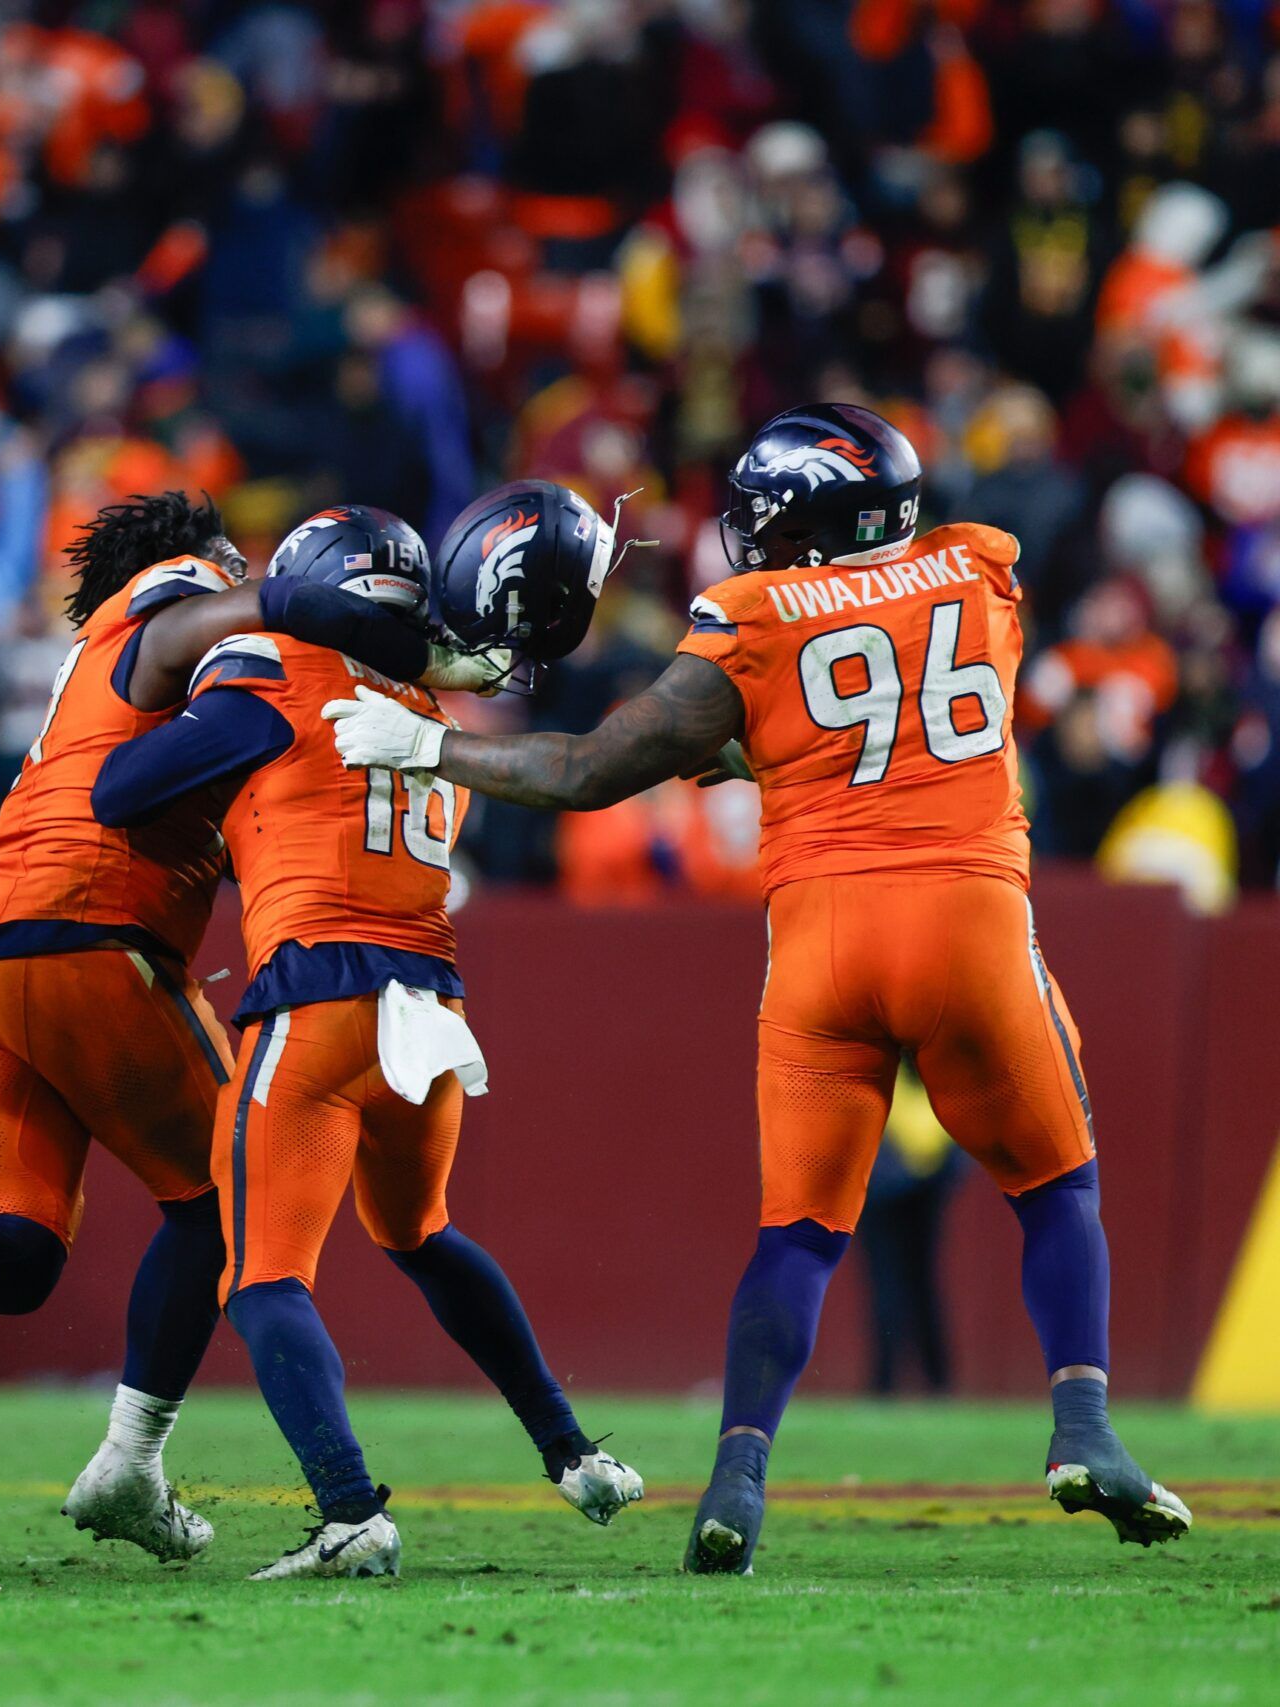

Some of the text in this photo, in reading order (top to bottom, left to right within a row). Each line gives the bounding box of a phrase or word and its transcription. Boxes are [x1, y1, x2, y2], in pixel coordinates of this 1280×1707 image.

[900, 494, 919, 530] 96
[386, 539, 414, 572] 15
[767, 544, 980, 624] UWAZURIKE
[798, 599, 1007, 788] 96
